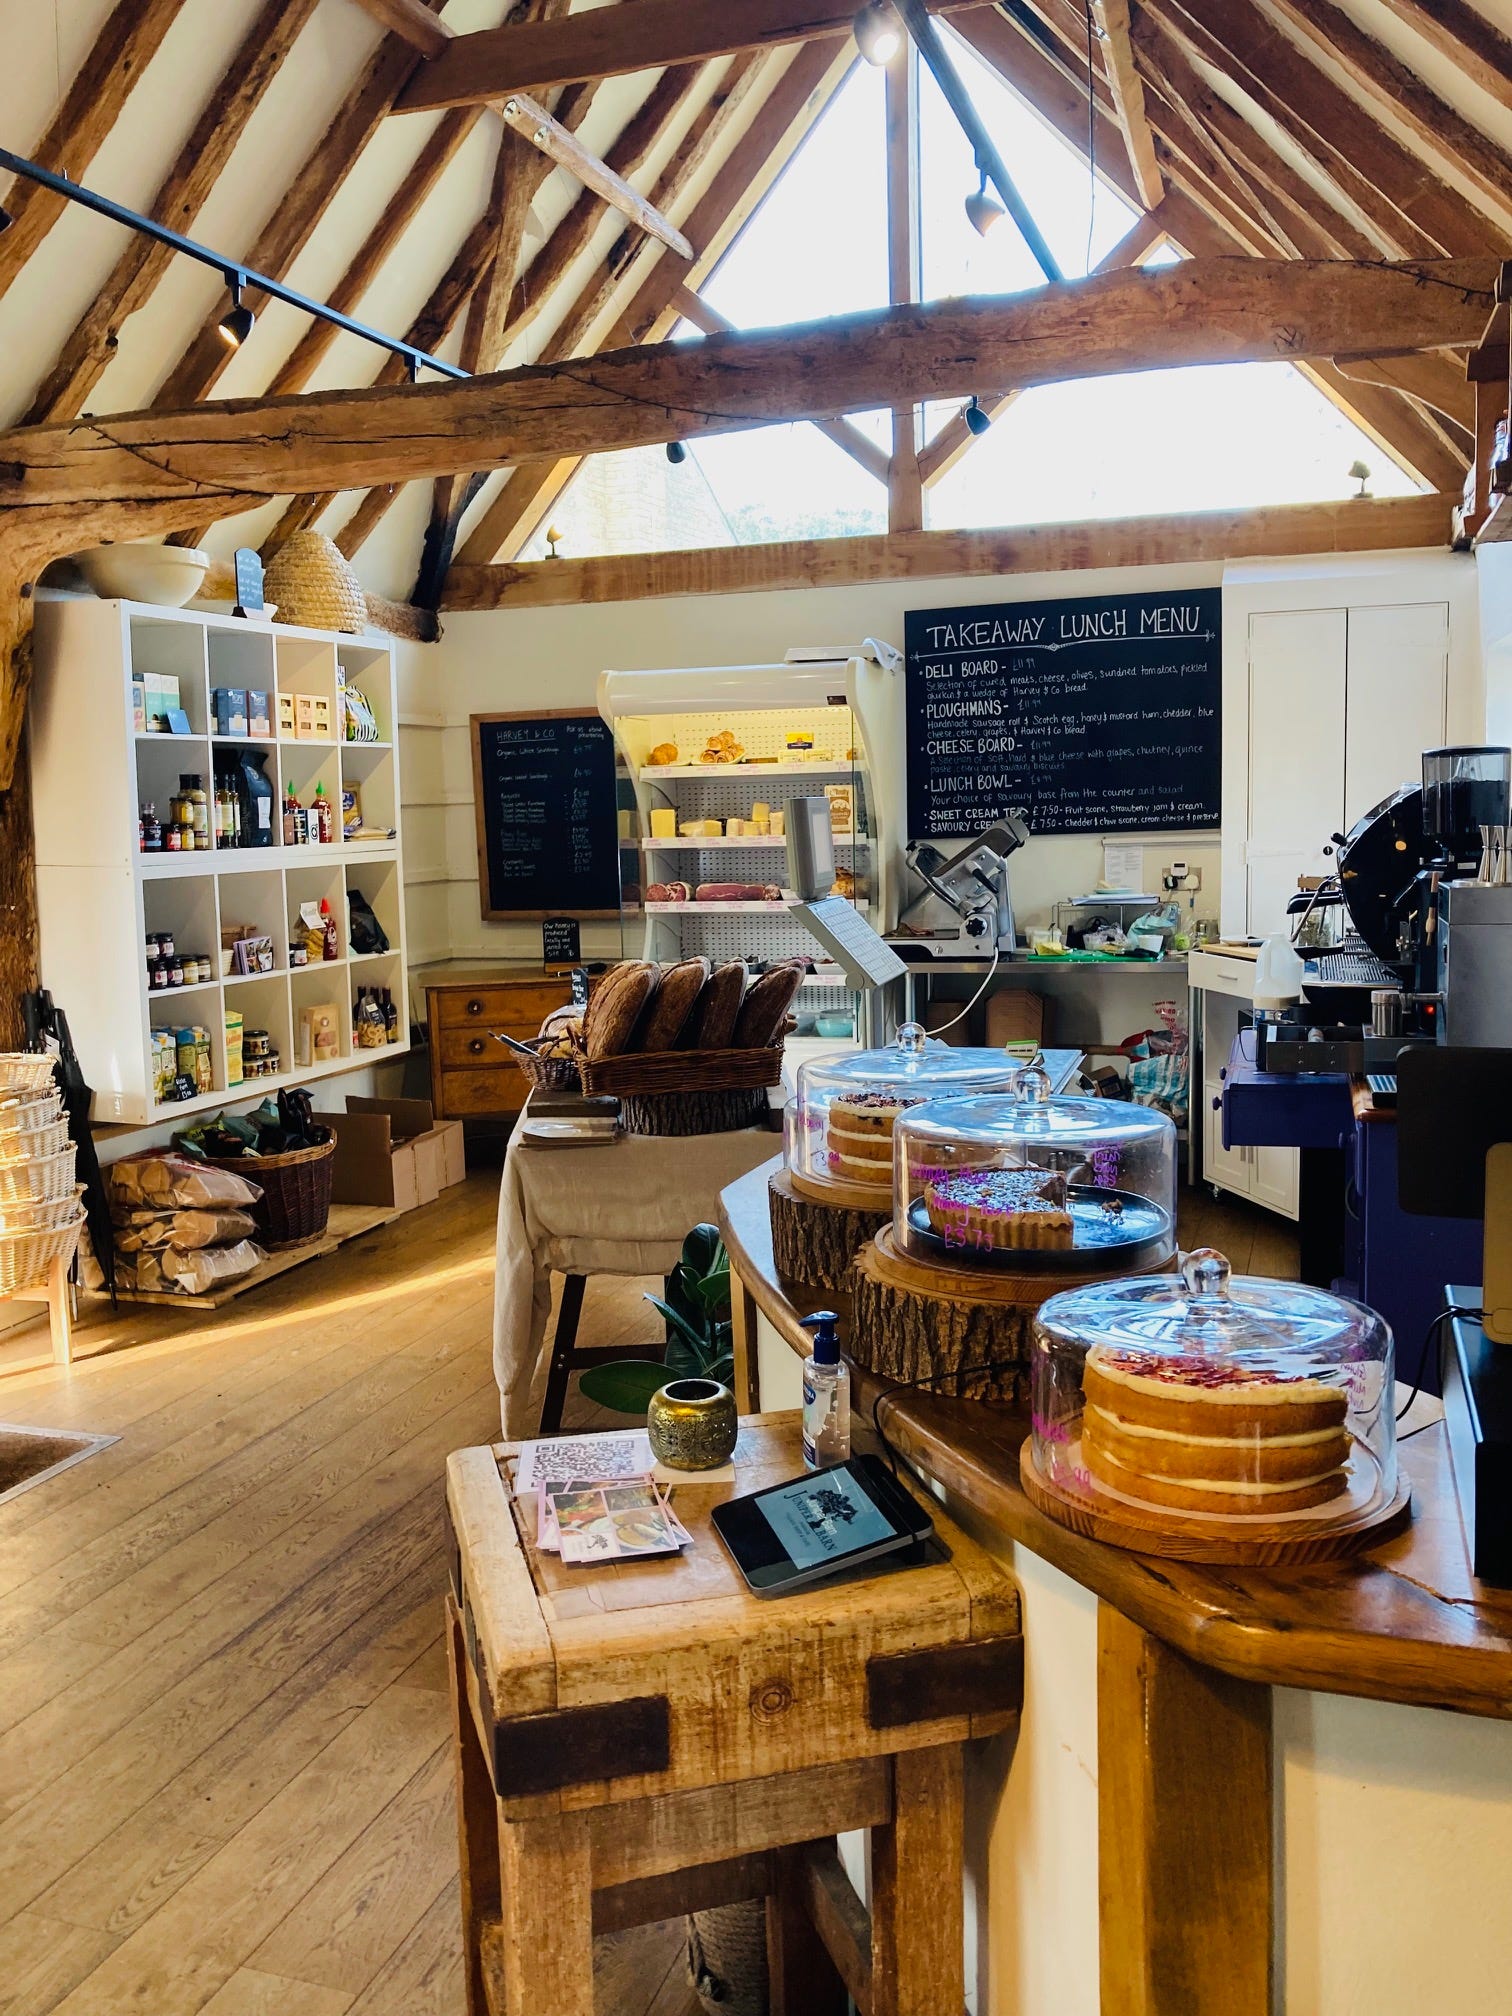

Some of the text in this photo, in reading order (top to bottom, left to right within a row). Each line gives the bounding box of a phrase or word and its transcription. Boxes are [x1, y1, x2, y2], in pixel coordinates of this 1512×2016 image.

[926, 606, 1200, 648] TAKEAWAY LUNCH MENU
[925, 664, 953, 679] DELI
[926, 680, 964, 692] Selection
[967, 680, 977, 690] of
[980, 677, 1006, 687] cured
[972, 687, 996, 700] wedge
[999, 688, 1008, 698] of
[1013, 686, 1041, 697] Harvey
[1050, 685, 1060, 695] Co
[927, 718, 969, 730] Handmade
[972, 719, 1006, 730] sausage
[1008, 717, 1021, 727] roll
[1033, 713, 1059, 725] Scotch
[1080, 711, 1102, 726] honey
[1109, 710, 1139, 722] mustard
[1198, 705, 1214, 717] blue
[497, 730, 529, 741] HARVEY
[542, 728, 556, 739] CO
[1021, 725, 1046, 736] Harvey
[1053, 726, 1062, 735] Co
[926, 739, 975, 755] CHEESE
[1088, 748, 1105, 759] with
[1175, 744, 1204, 758] quince
[930, 776, 973, 792] LUNCH
[953, 793, 979, 804] choice
[983, 793, 993, 803] of
[998, 791, 1032, 804] savoury
[1038, 789, 1057, 800] base
[1060, 787, 1080, 800] from
[1083, 788, 1098, 798] the
[1102, 788, 1136, 798] counter
[1138, 785, 1155, 796] and
[1158, 784, 1184, 795] salad
[929, 809, 962, 821] SWEET
[965, 807, 999, 819] CREAM
[1065, 806, 1083, 815] Fruit
[1152, 803, 1168, 813] jam
[930, 821, 971, 833] SAVOURY
[1141, 815, 1160, 824] cream
[1161, 813, 1185, 823] cheese
[816, 1530, 838, 1551] BARN
